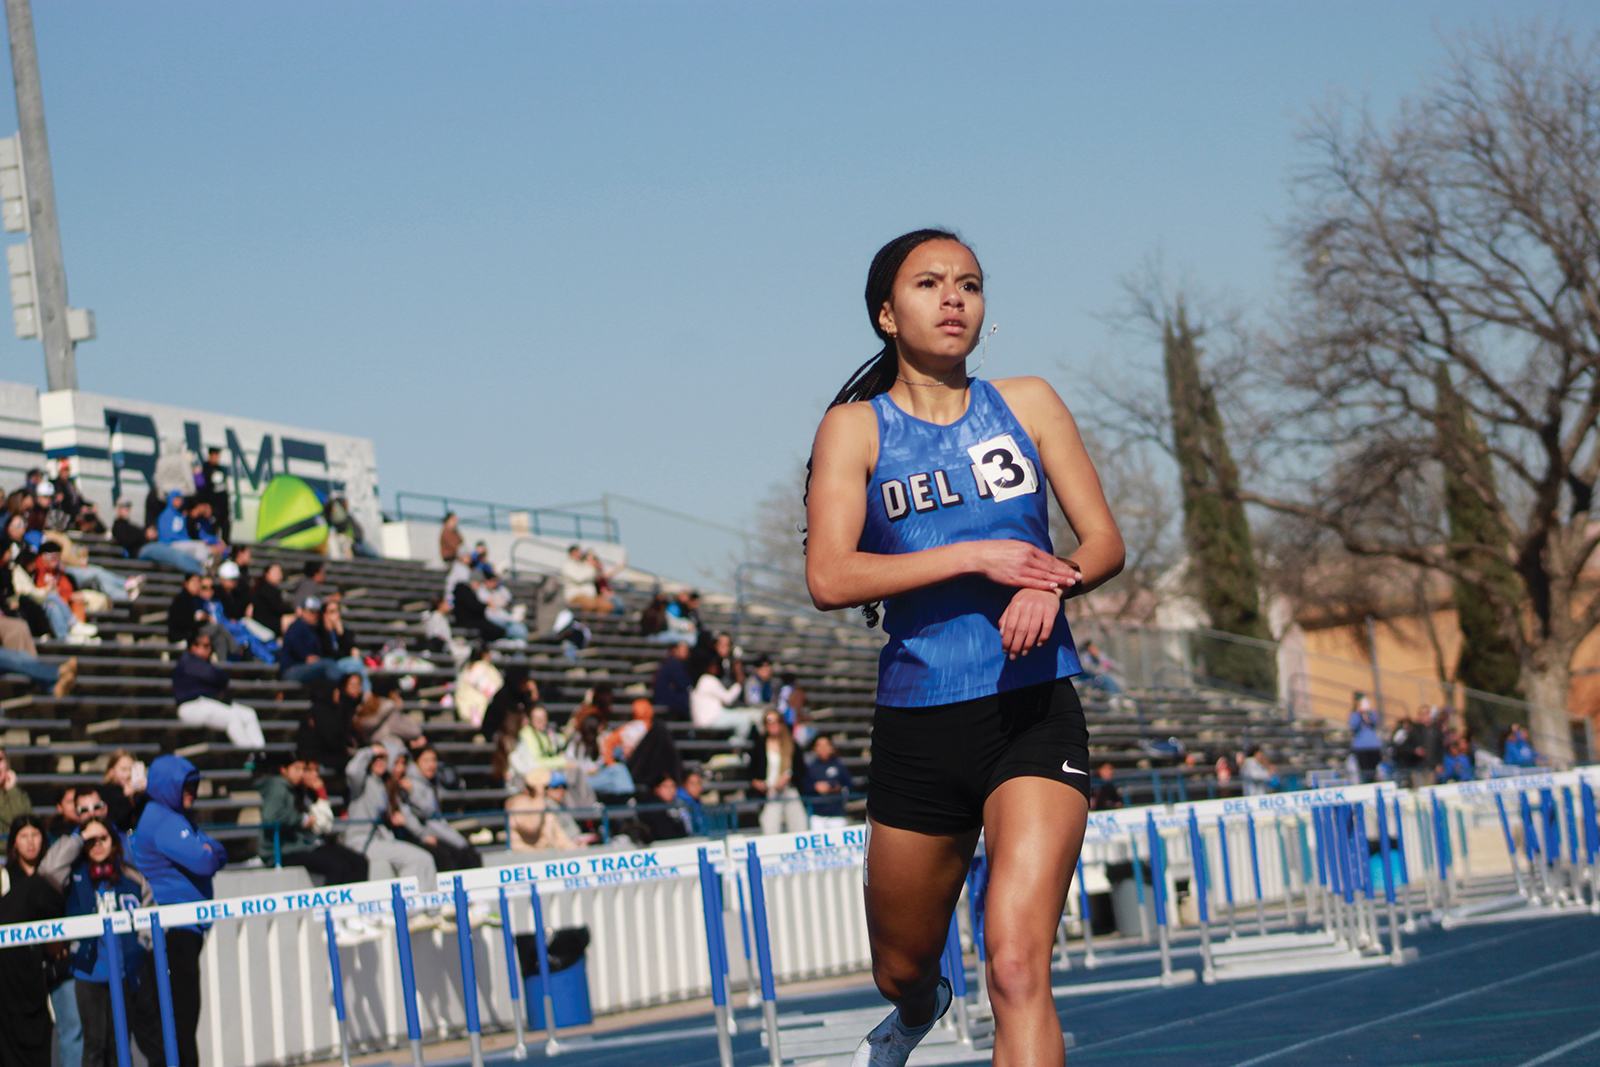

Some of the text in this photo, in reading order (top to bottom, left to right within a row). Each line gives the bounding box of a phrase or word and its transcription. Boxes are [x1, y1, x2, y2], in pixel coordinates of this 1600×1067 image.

[981, 448, 1025, 489] 3
[880, 469, 964, 523] DEL
[1223, 800, 1250, 813] DEL
[1258, 795, 1286, 810] RIO
[1290, 789, 1346, 806] TRACK
[1088, 812, 1118, 827] ACK
[795, 832, 835, 851] DEL
[843, 829, 866, 846] RI
[500, 851, 659, 884] DEL RIO TRACK
[196, 888, 355, 921] DEL RIO TRACK
[358, 900, 384, 915] DEL
